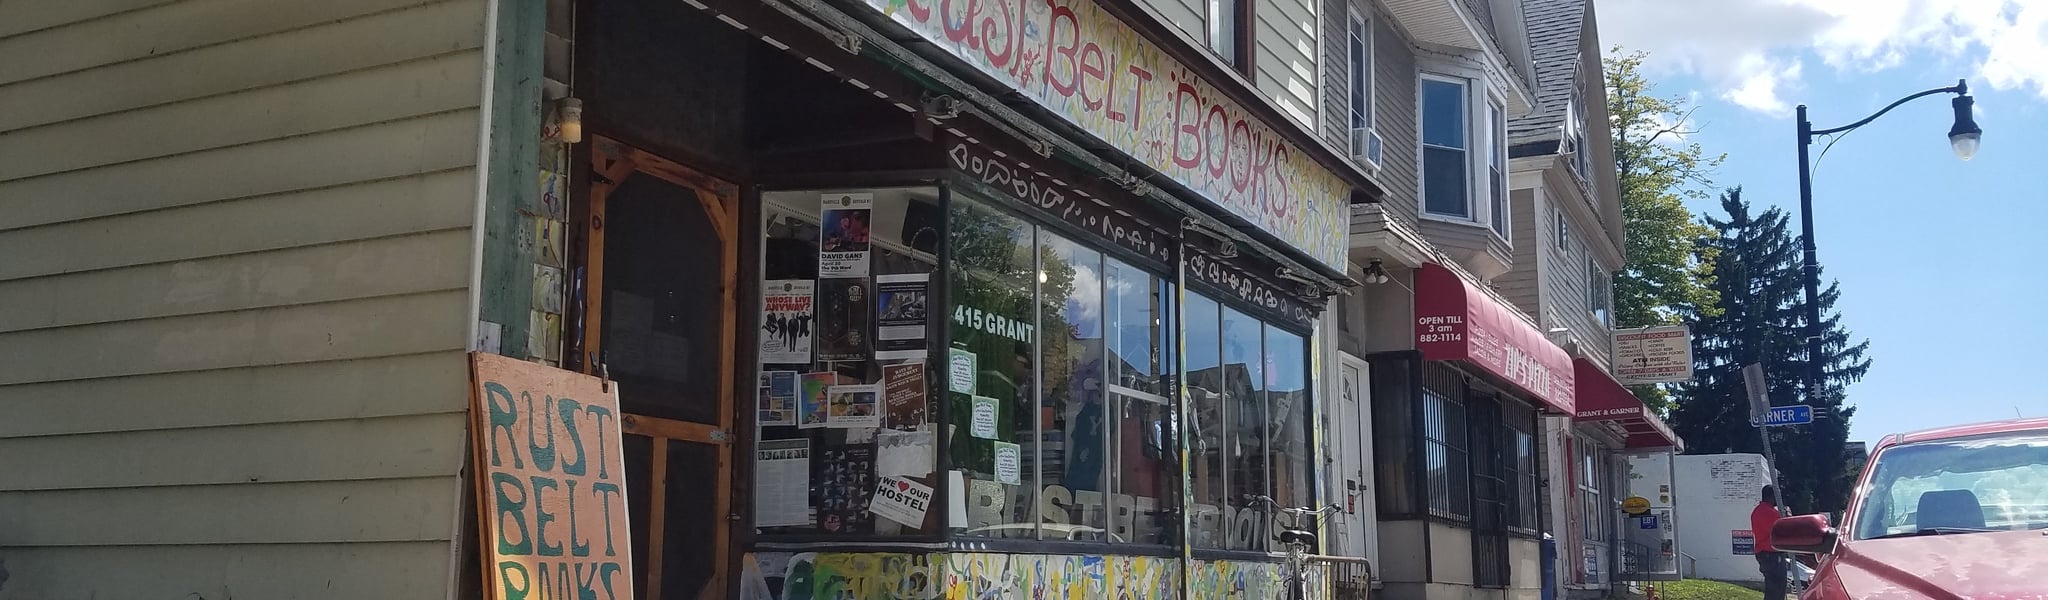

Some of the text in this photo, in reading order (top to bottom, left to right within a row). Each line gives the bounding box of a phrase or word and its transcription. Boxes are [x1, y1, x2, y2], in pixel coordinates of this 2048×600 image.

[1172, 82, 1289, 218] BOOKS
[765, 303, 811, 312] ANYWAY?
[954, 304, 1034, 344] 415 GRANT
[1418, 315, 1463, 325] OPEN TILL
[1428, 324, 1435, 333] 3
[1420, 333, 1462, 343] 882-1114
[1576, 409, 1602, 418] GRANT
[1609, 406, 1640, 415] GARNER
[484, 381, 613, 479] RUST
[882, 476, 930, 501] WE OUR
[877, 485, 925, 513] HOSTEL
[491, 471, 620, 557] BELT
[1642, 515, 1655, 524] EBT
